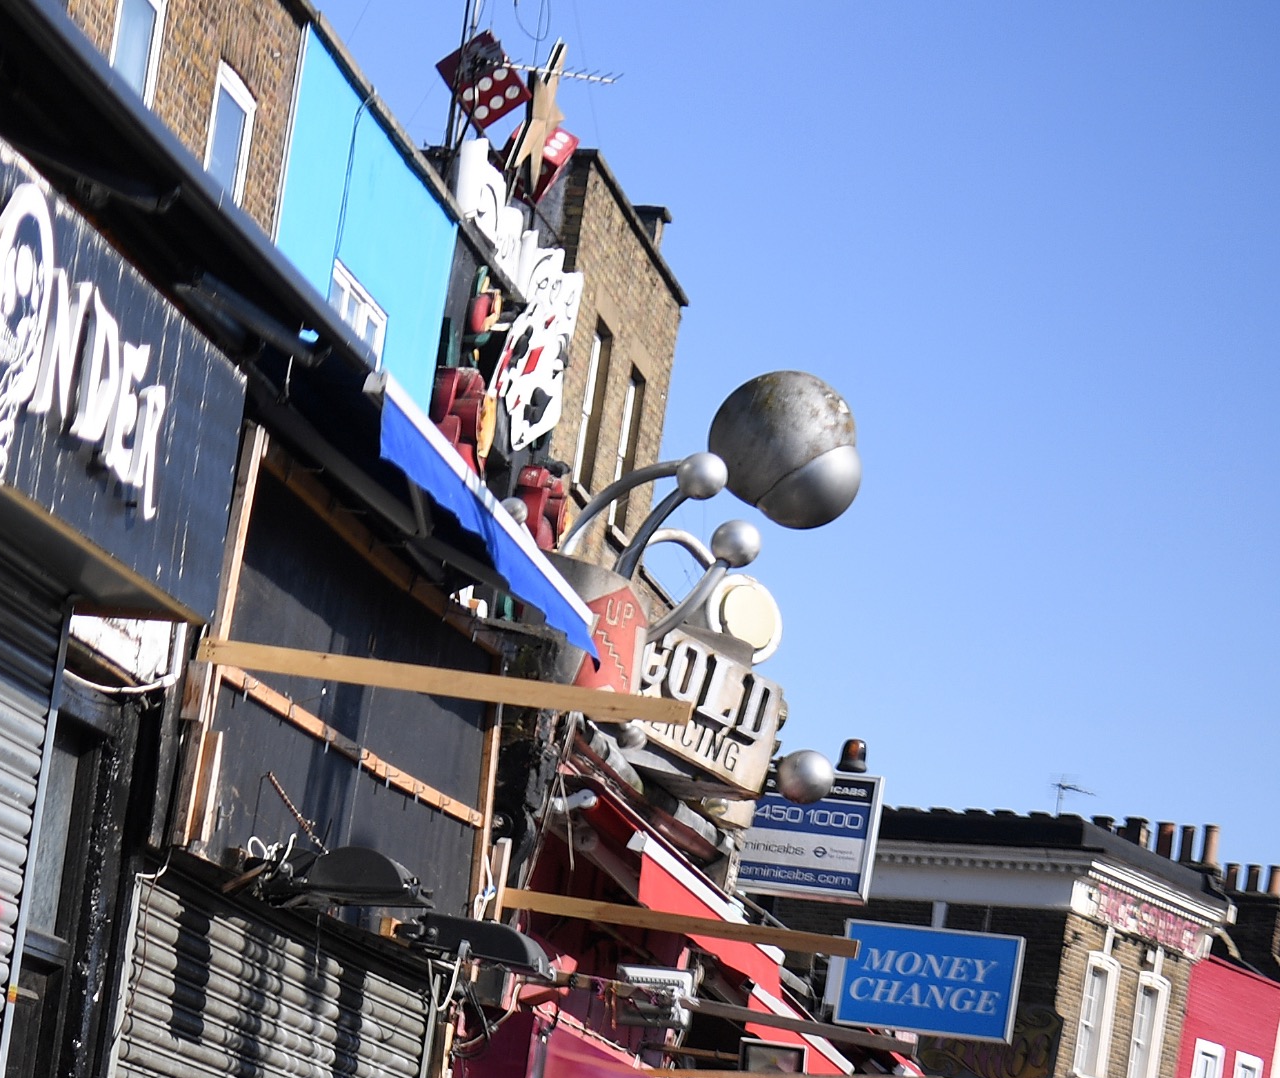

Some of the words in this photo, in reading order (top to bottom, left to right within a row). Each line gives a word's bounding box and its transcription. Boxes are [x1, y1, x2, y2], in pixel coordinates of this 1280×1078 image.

[606, 598, 636, 629] UP
[641, 637, 772, 744] GOLD
[861, 948, 998, 985] MONEY
[849, 976, 1001, 1016] CHANGE
